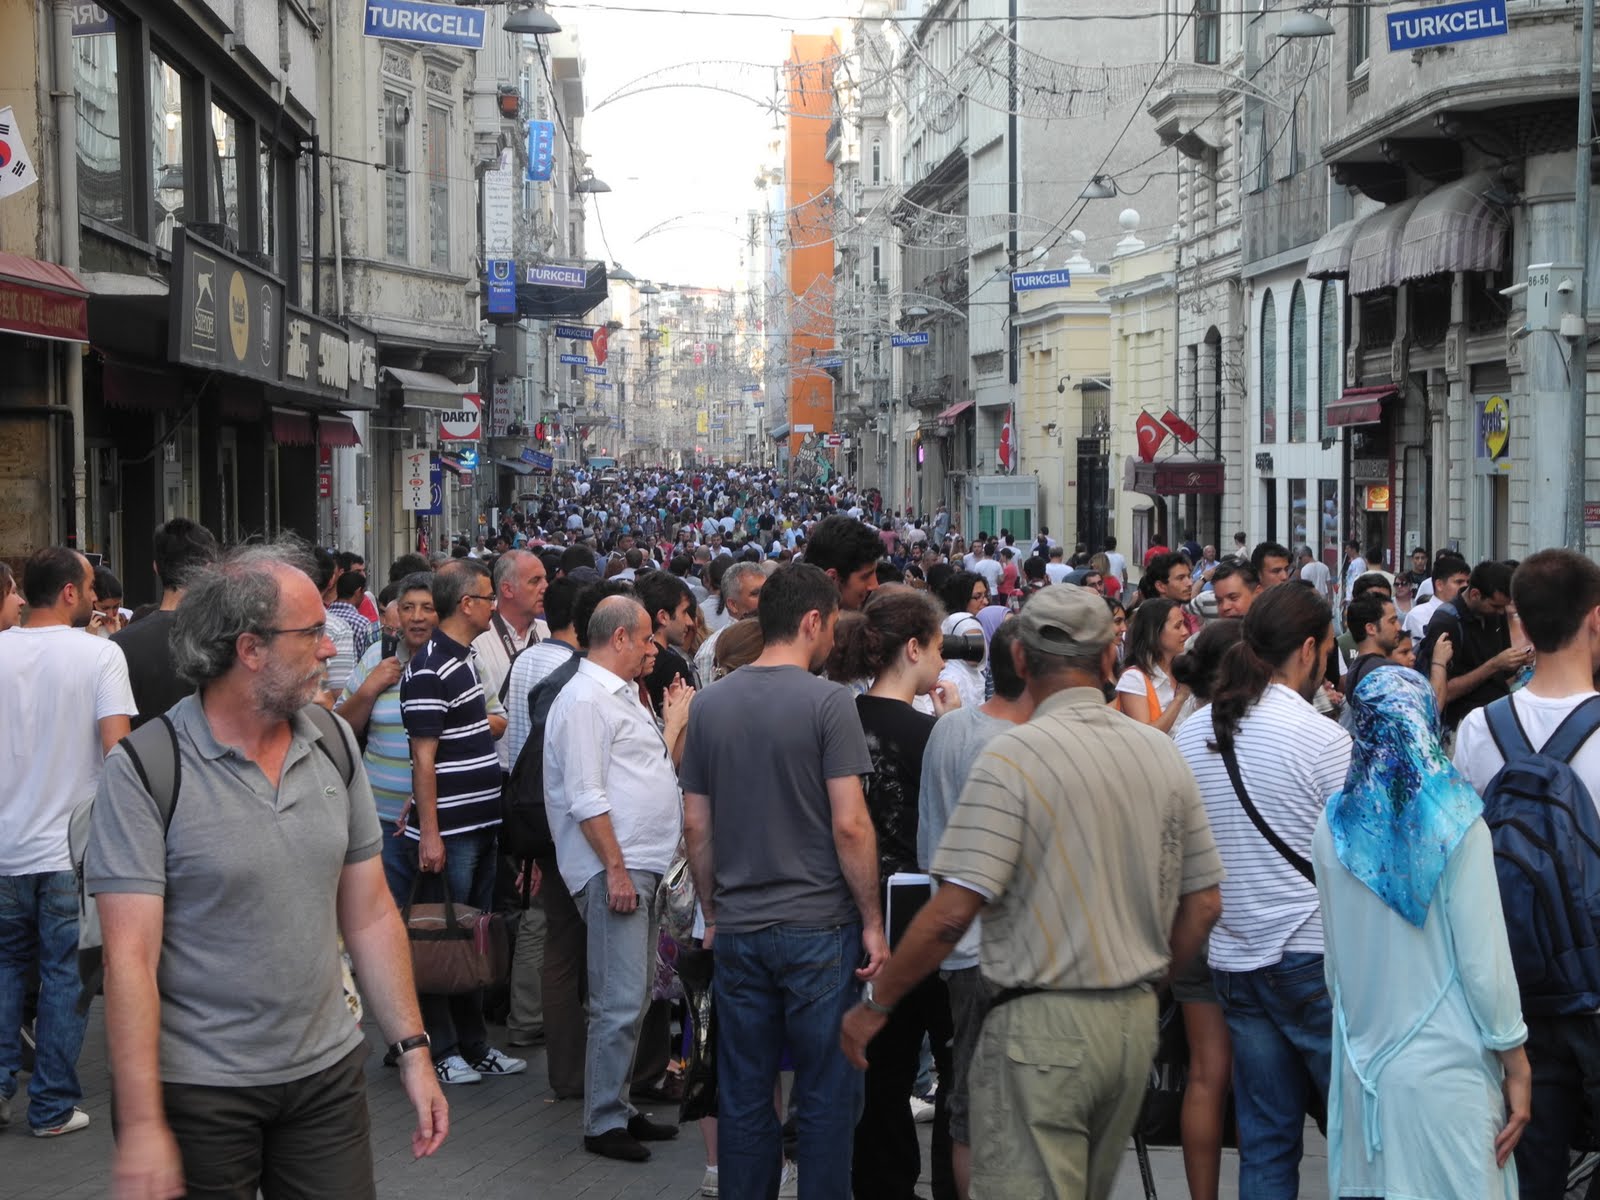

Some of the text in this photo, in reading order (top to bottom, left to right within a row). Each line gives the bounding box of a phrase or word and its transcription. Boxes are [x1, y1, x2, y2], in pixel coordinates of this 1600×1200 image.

[368, 6, 480, 38] TURKCELL
[1391, 7, 1504, 41] TURKCELL
[529, 268, 583, 283] TURKCELL
[1014, 273, 1068, 287] TURKCELL
[557, 327, 592, 338] TURKCELL
[561, 355, 588, 363] TURKCELL
[442, 411, 478, 423] DARTY
